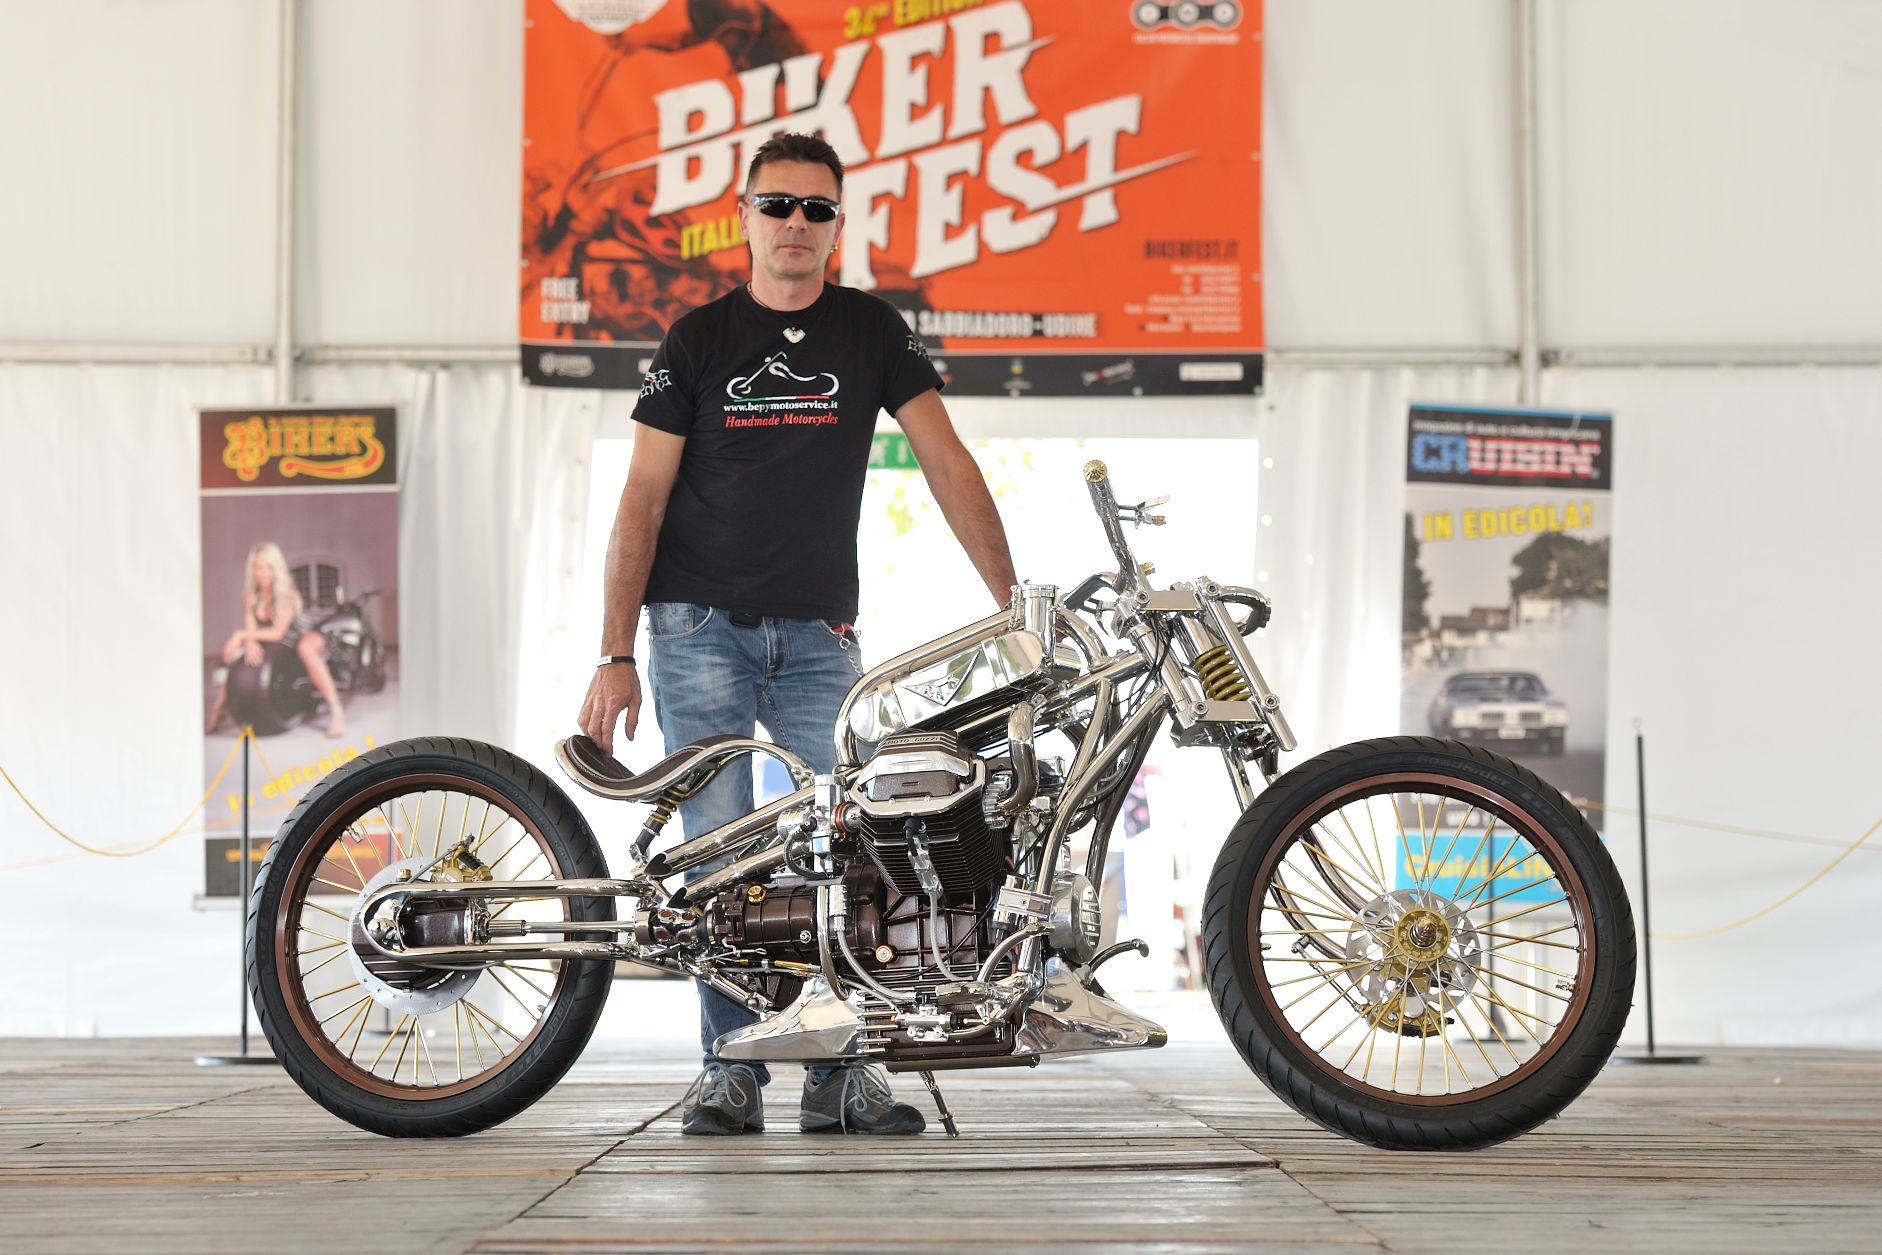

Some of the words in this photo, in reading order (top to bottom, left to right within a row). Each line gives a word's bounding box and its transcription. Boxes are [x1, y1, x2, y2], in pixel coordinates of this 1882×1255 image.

[650, 1, 1038, 217] BIKER
[836, 94, 1142, 290] FEST
[681, 216, 749, 260] ITALI
[723, 400, 838, 413] www.bepymotoservice.it
[725, 414, 780, 428] Handmade
[782, 412, 838, 426] Motorcycles
[1424, 511, 1452, 541] IN
[1462, 501, 1593, 538] EDICOLA!
